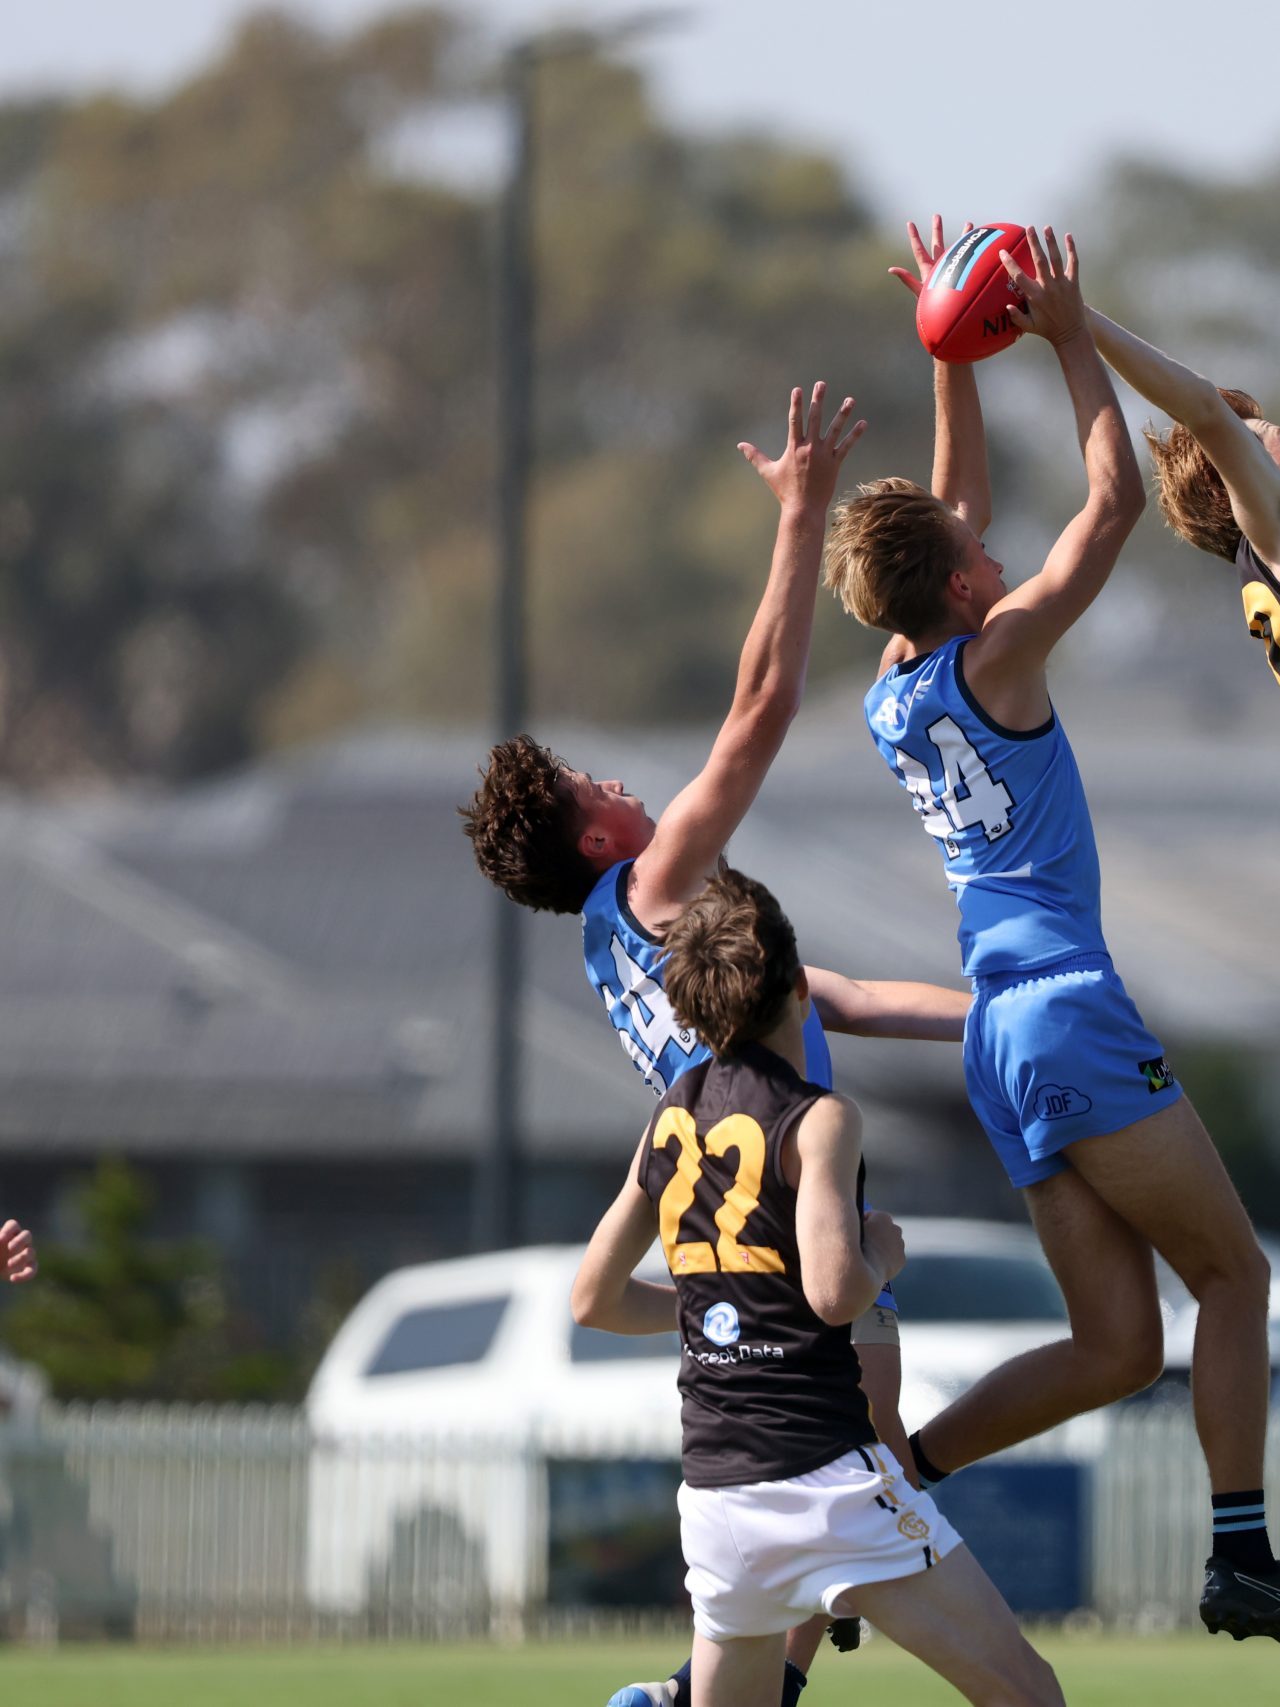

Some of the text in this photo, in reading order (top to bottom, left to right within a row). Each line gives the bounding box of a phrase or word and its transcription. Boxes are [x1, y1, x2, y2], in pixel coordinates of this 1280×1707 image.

[1044, 1092, 1072, 1116] JDF
[653, 1106, 786, 1275] 22
[738, 1344, 785, 1360] Data
